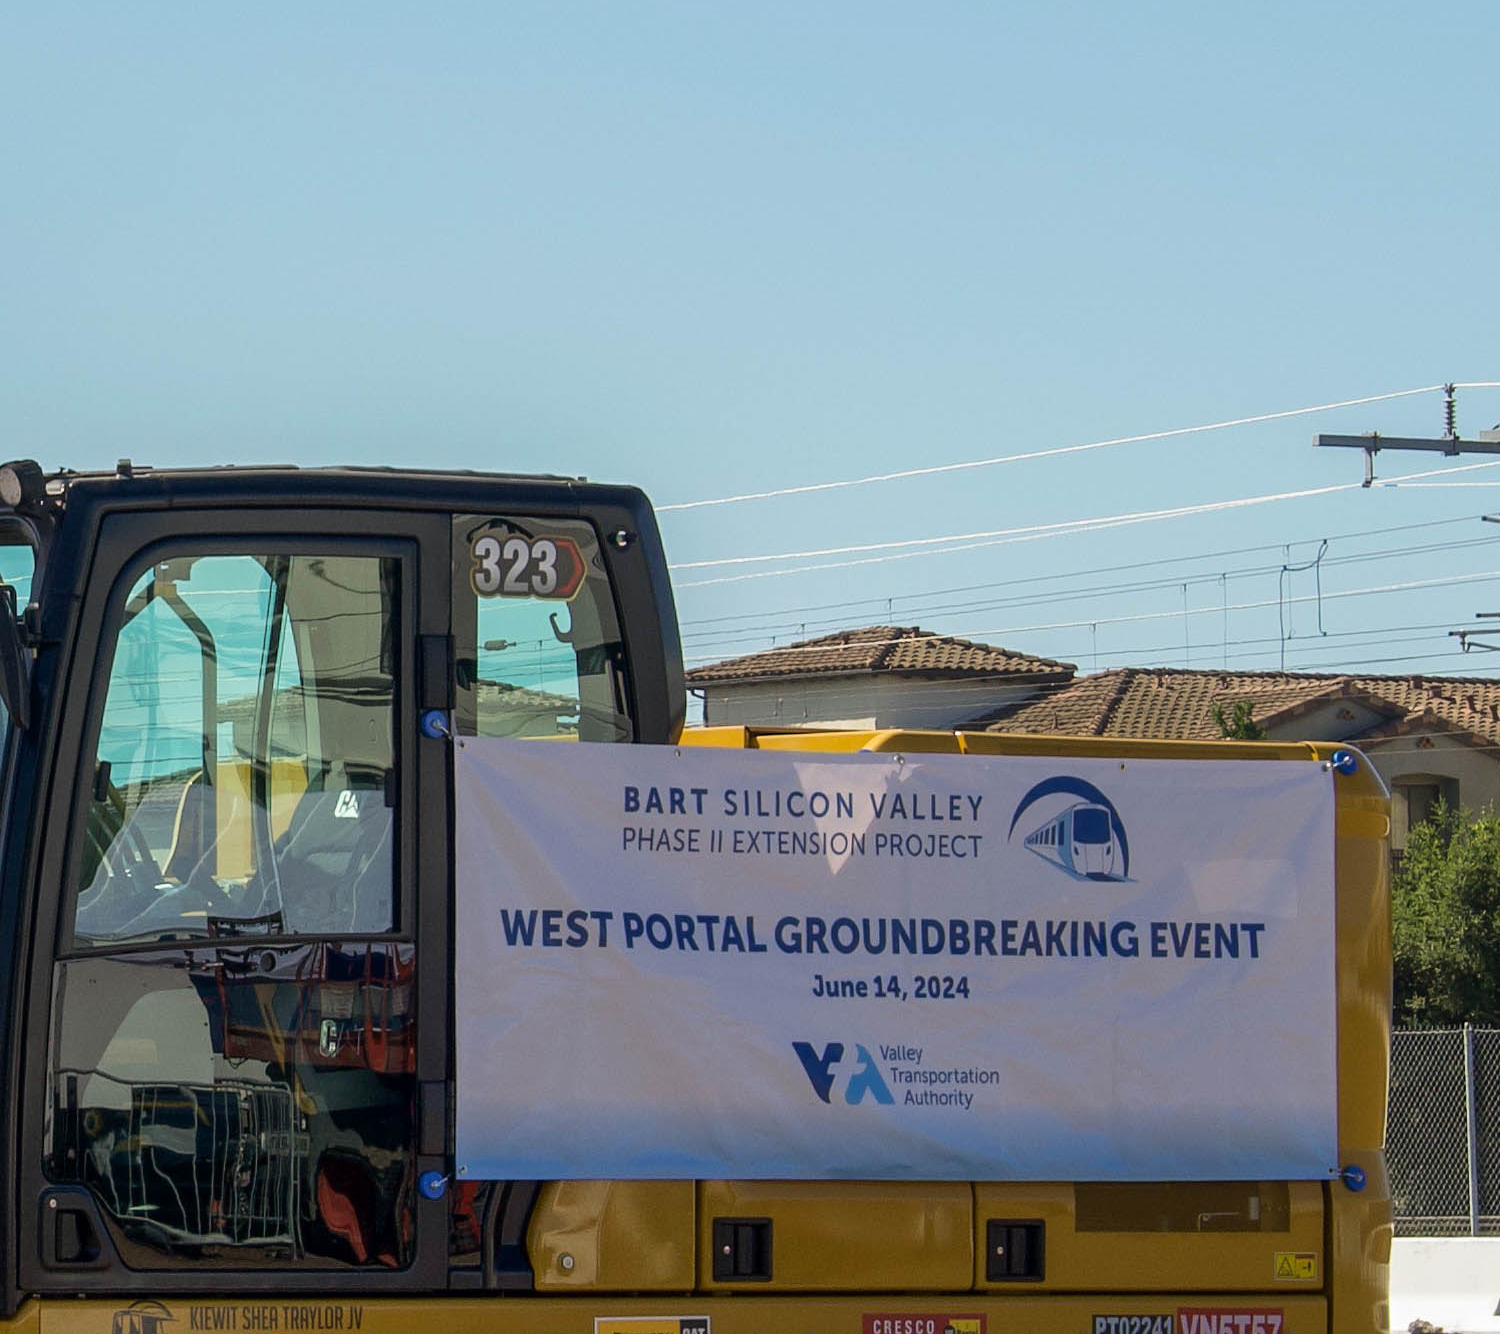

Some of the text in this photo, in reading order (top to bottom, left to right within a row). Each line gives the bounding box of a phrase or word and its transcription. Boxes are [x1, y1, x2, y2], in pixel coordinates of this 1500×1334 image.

[475, 537, 557, 593] 323
[624, 786, 983, 821] BART SILICON VALLEY
[623, 827, 983, 859] PHASE II EXTENSION PROJECT
[500, 909, 1265, 958] WEST PORTAL GROUNDBREAKING EVENT
[812, 975, 970, 1001] June 14, 2024
[880, 1044, 923, 1065] Valley
[890, 1068, 1000, 1087] Transportation
[904, 1090, 974, 1110] Authority
[190, 1306, 363, 1331] KIEWIT SHEA TRAYLOR JV
[873, 1320, 935, 1334] CRESCO
